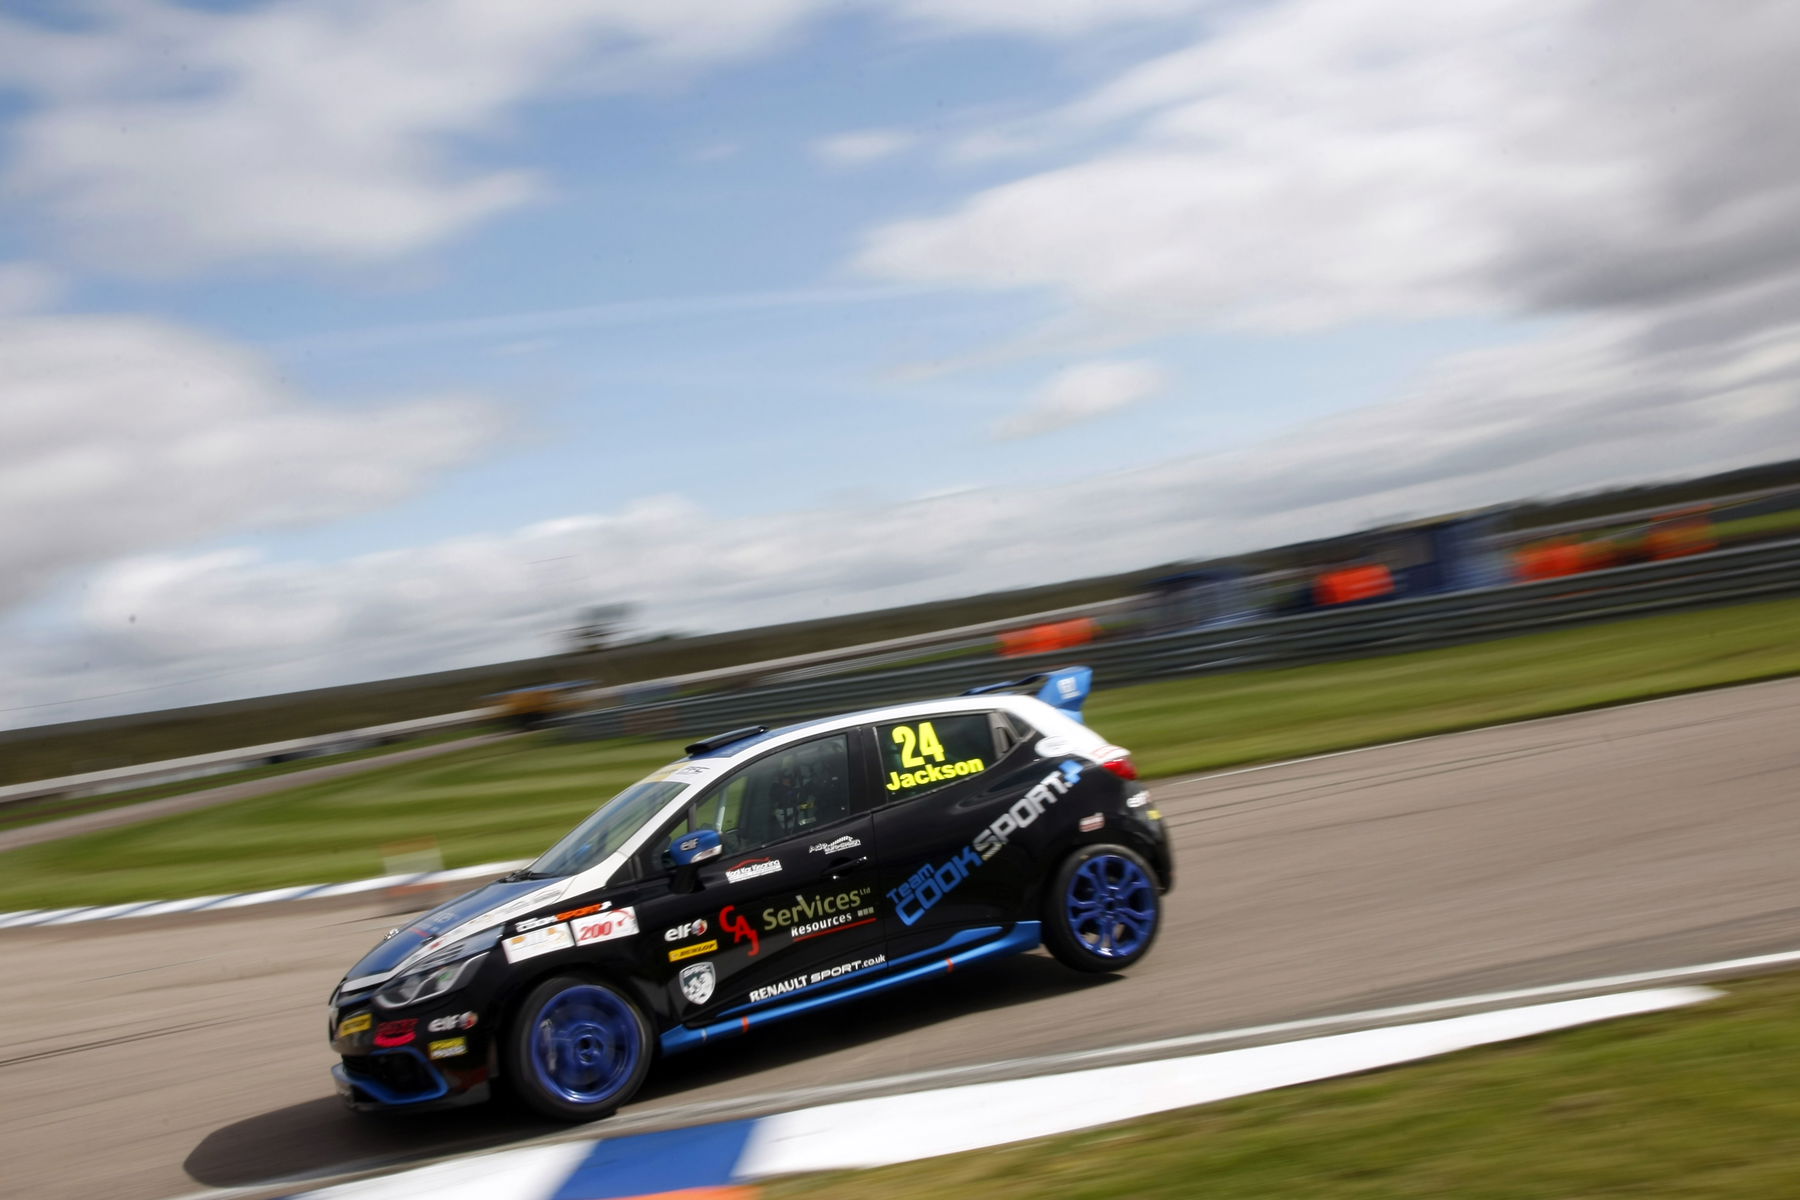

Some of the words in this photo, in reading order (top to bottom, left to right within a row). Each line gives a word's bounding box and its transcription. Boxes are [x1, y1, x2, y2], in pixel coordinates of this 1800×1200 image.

[892, 722, 945, 768] 24
[886, 758, 984, 791] Jackson
[664, 922, 693, 941] elf
[719, 905, 760, 956] CAJ
[791, 912, 852, 937] Resources
[749, 975, 808, 1002] RENAULT
